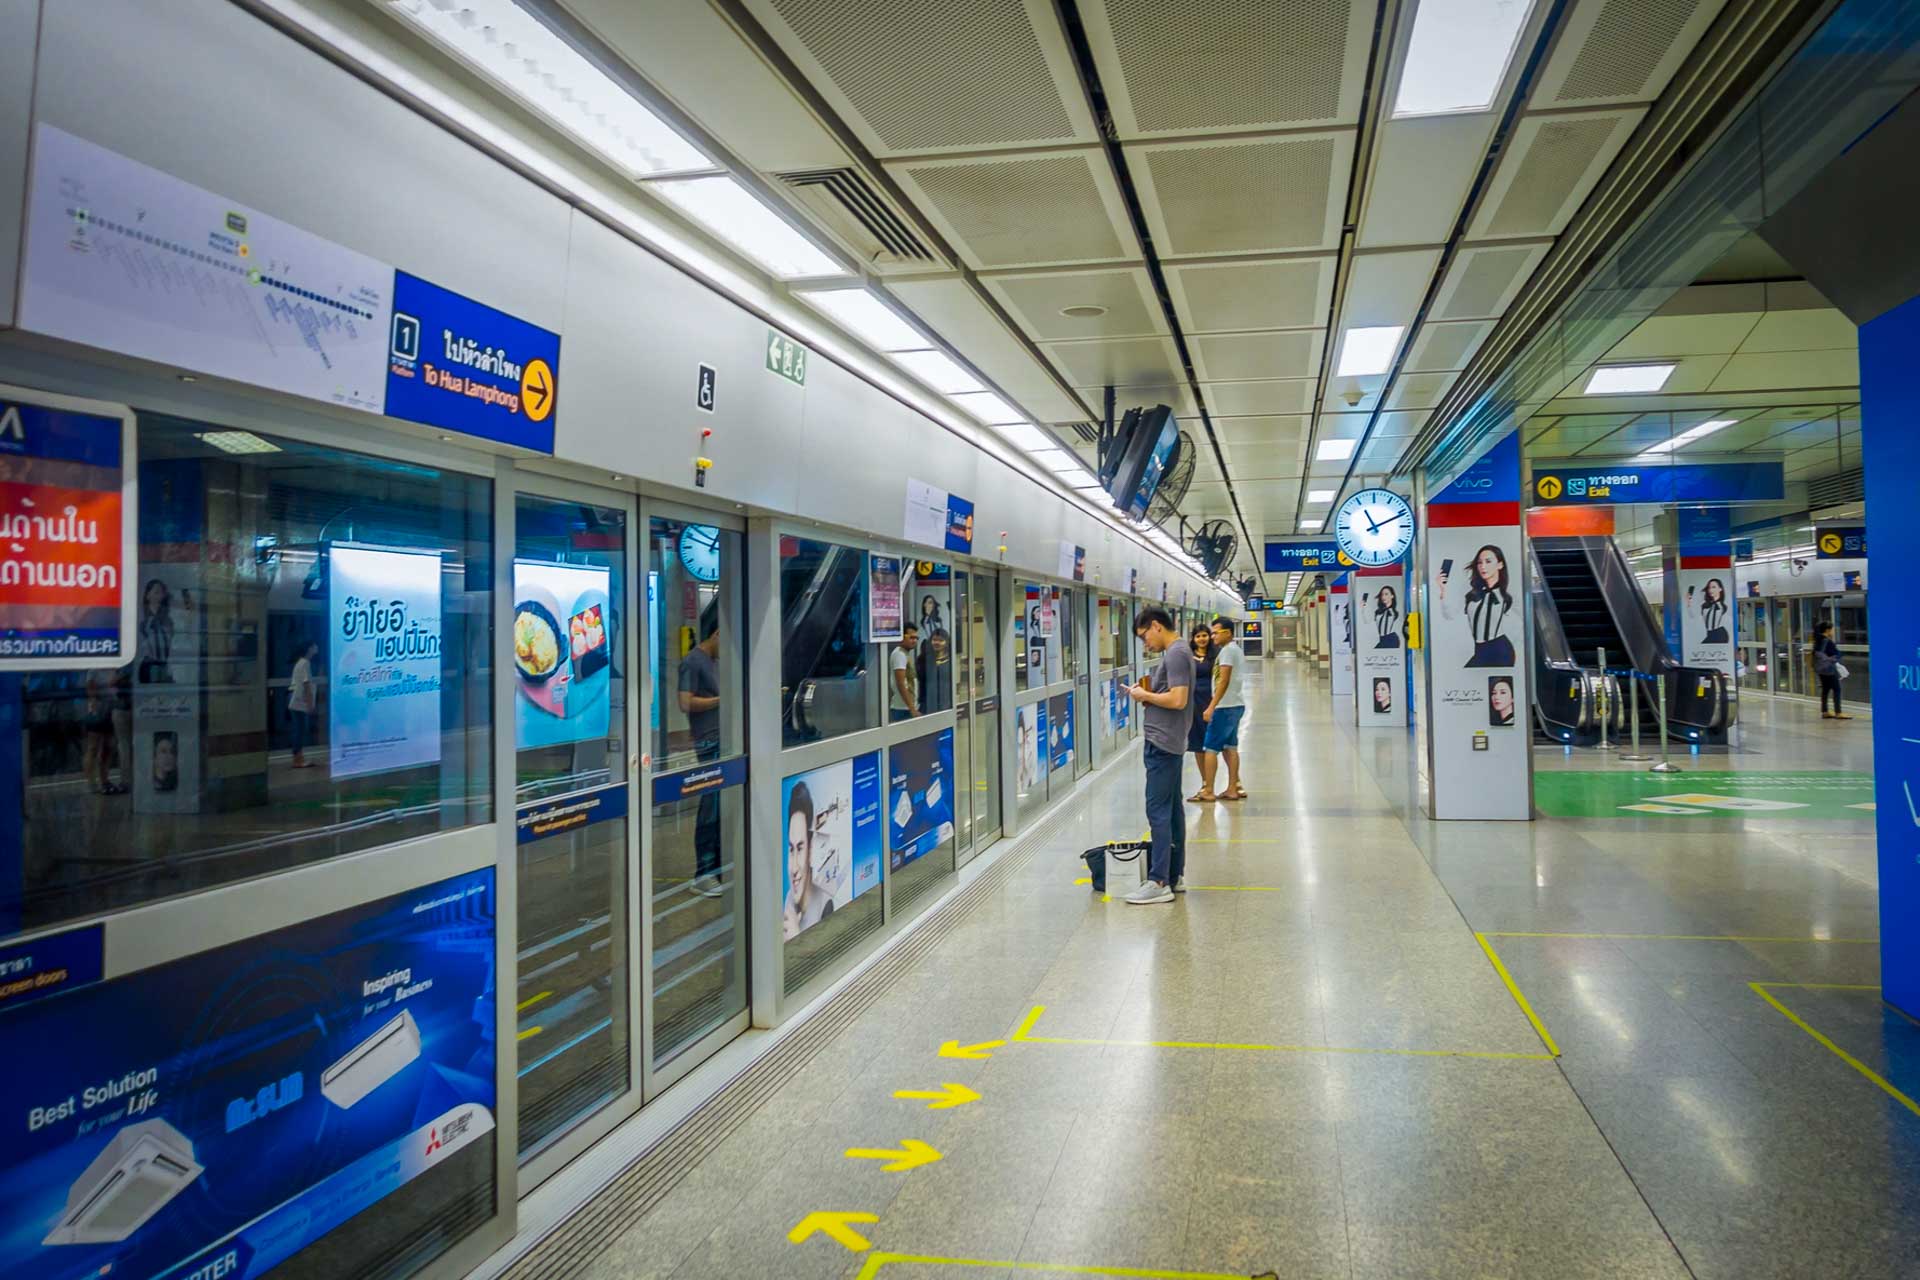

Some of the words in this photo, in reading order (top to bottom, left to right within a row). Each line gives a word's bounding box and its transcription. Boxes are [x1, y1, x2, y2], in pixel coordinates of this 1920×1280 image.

[402, 326, 410, 350] 1
[444, 329, 521, 381] ไปหัวลำโพง
[423, 364, 438, 384] To
[439, 369, 463, 392] Hua
[464, 377, 519, 413] Lamphong
[1588, 475, 1638, 485] ทางออก
[1588, 486, 1610, 497] Exit
[0, 543, 117, 588] ด้านนอก
[1281, 548, 1320, 557] ทางออก
[1302, 557, 1320, 566] Exit
[363, 968, 411, 997] Inspiring
[29, 1096, 76, 1132] Best
[82, 1067, 157, 1109] Solution
[127, 1088, 159, 1116] Life
